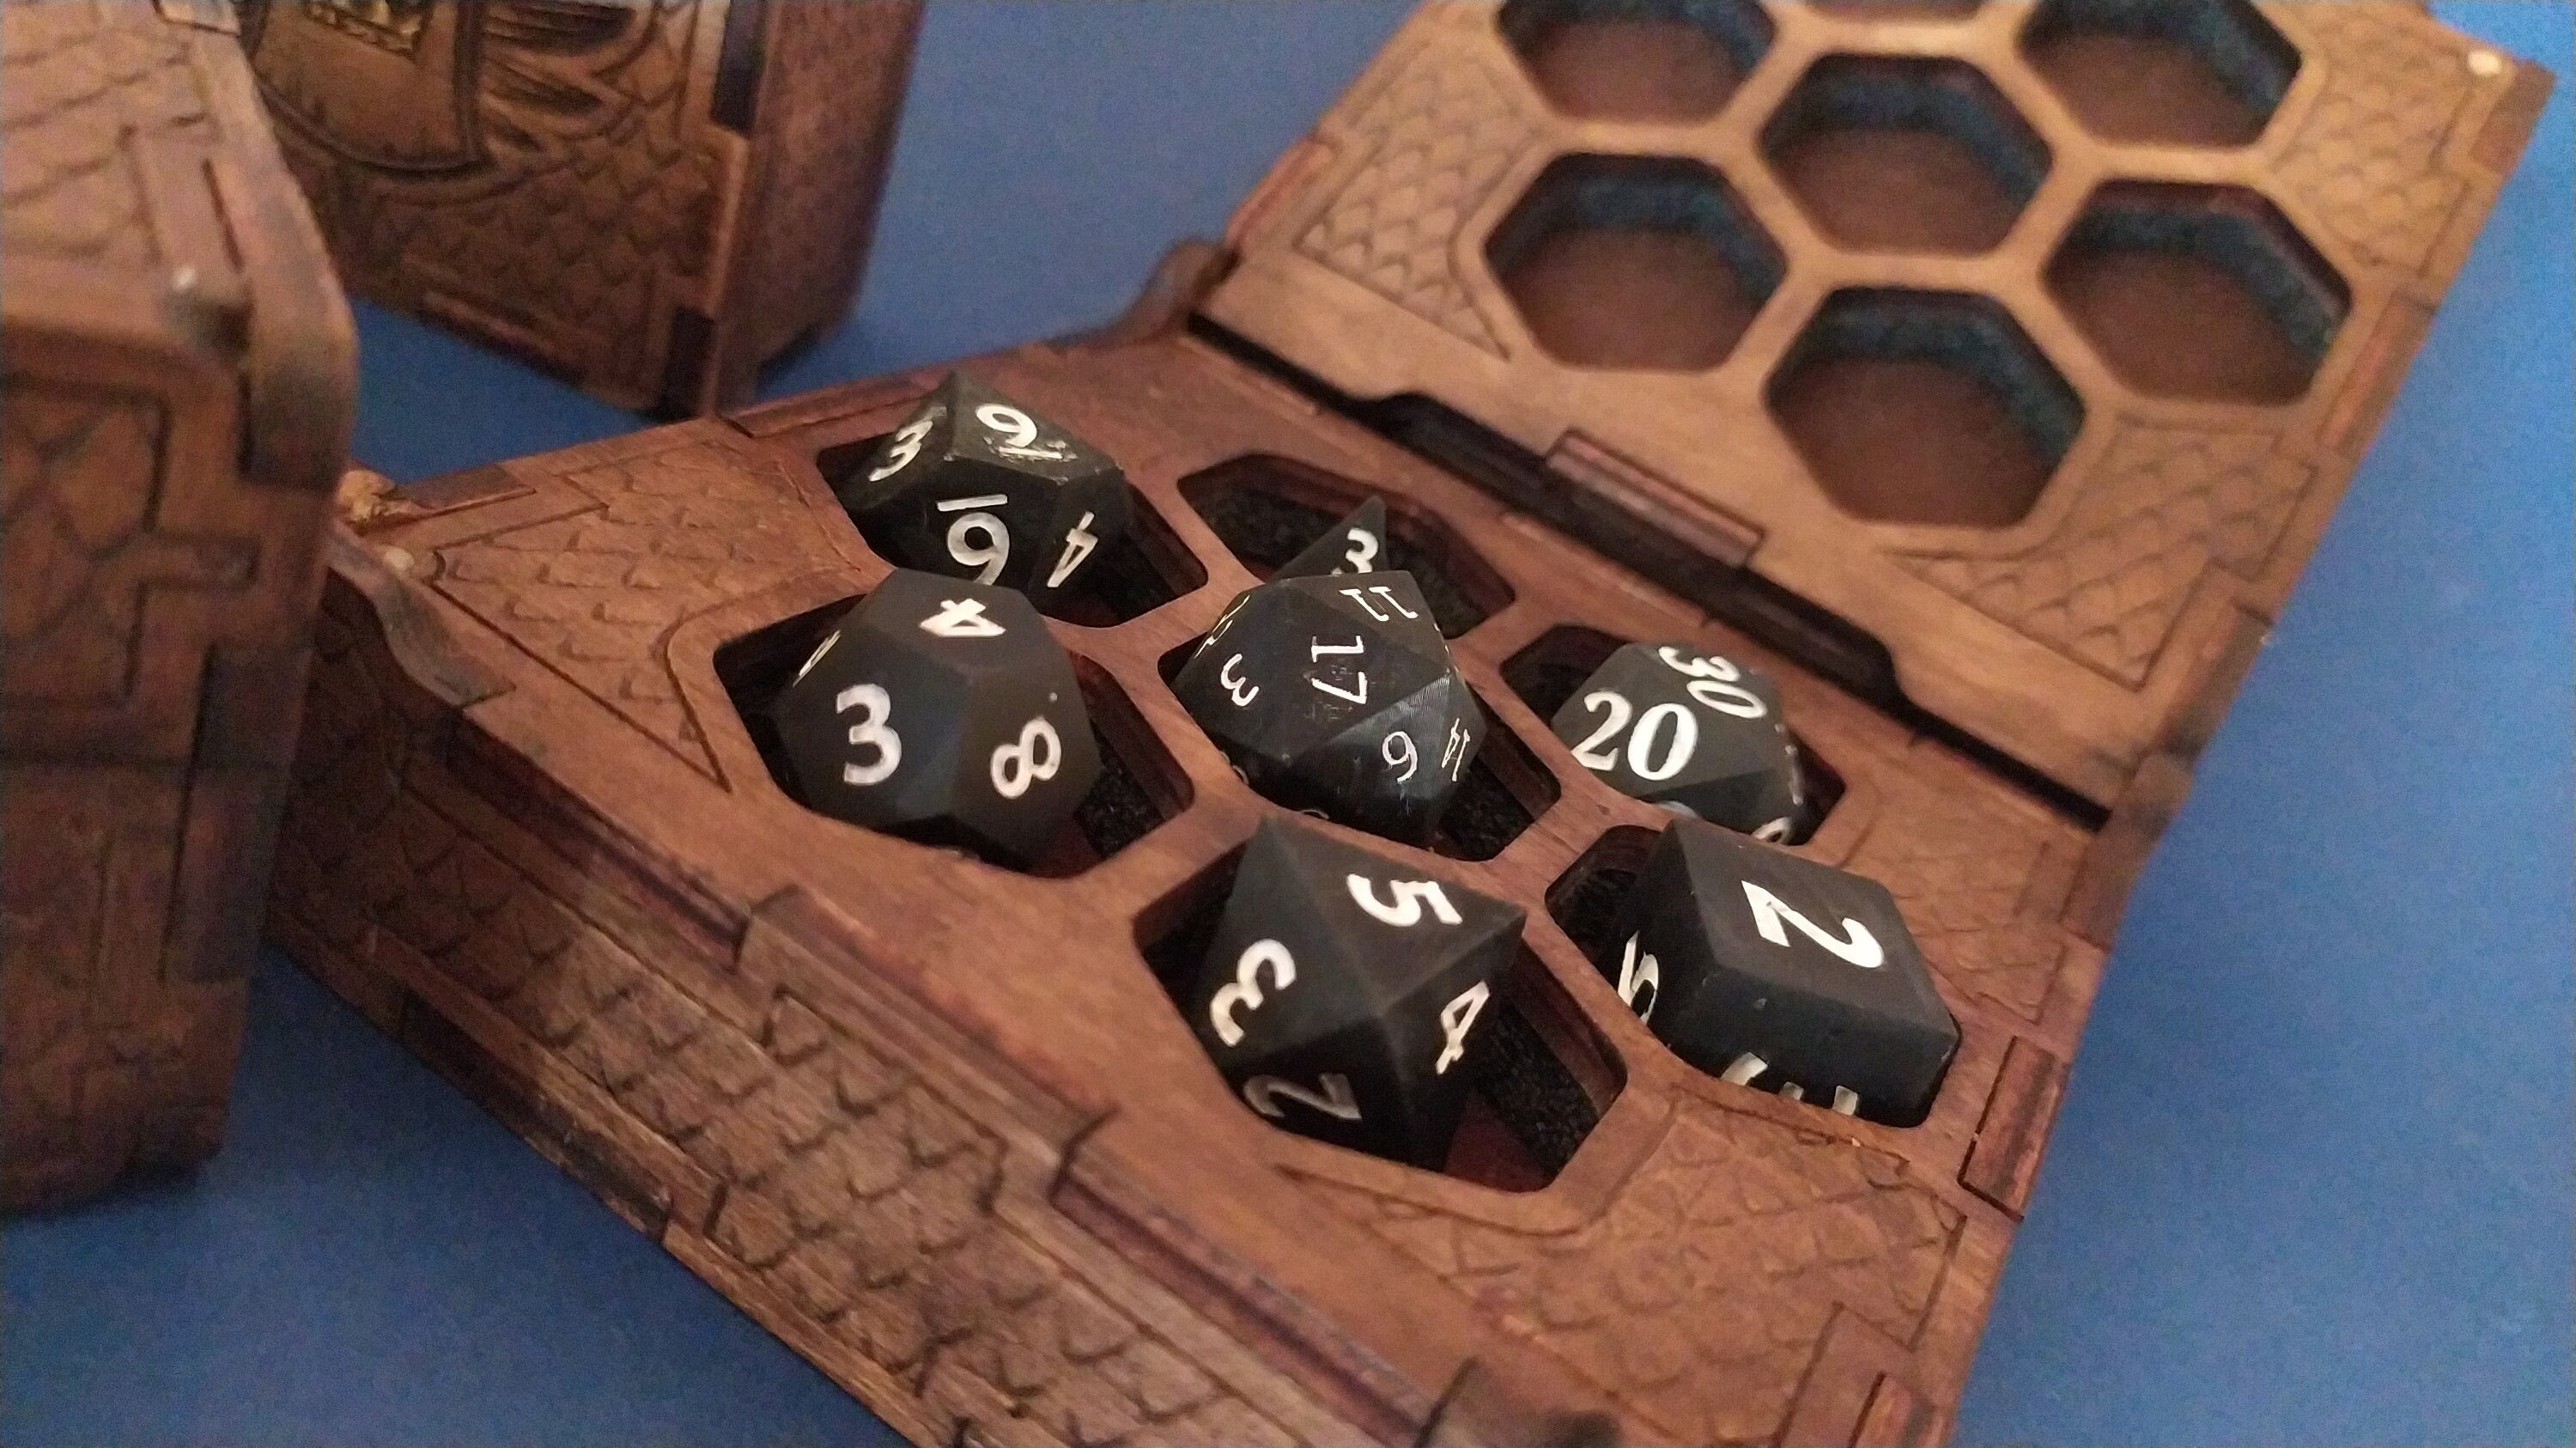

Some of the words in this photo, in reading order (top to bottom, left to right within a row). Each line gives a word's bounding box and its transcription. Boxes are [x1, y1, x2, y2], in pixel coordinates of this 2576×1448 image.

[869, 420, 934, 482] 3
[1047, 513, 1099, 588] 4
[918, 598, 1007, 637] 4
[1338, 586, 1419, 622] 11
[1220, 653, 1260, 707] 3
[1310, 635, 1368, 705] 17
[1658, 646, 1768, 719] 30
[836, 684, 902, 787] 3
[990, 716, 1062, 799] 8
[1571, 691, 1699, 782] 20
[1346, 873, 1463, 928] 5
[1741, 879, 1886, 969] 2
[1210, 939, 1297, 1048] 3
[1436, 980, 1491, 1076] 4
